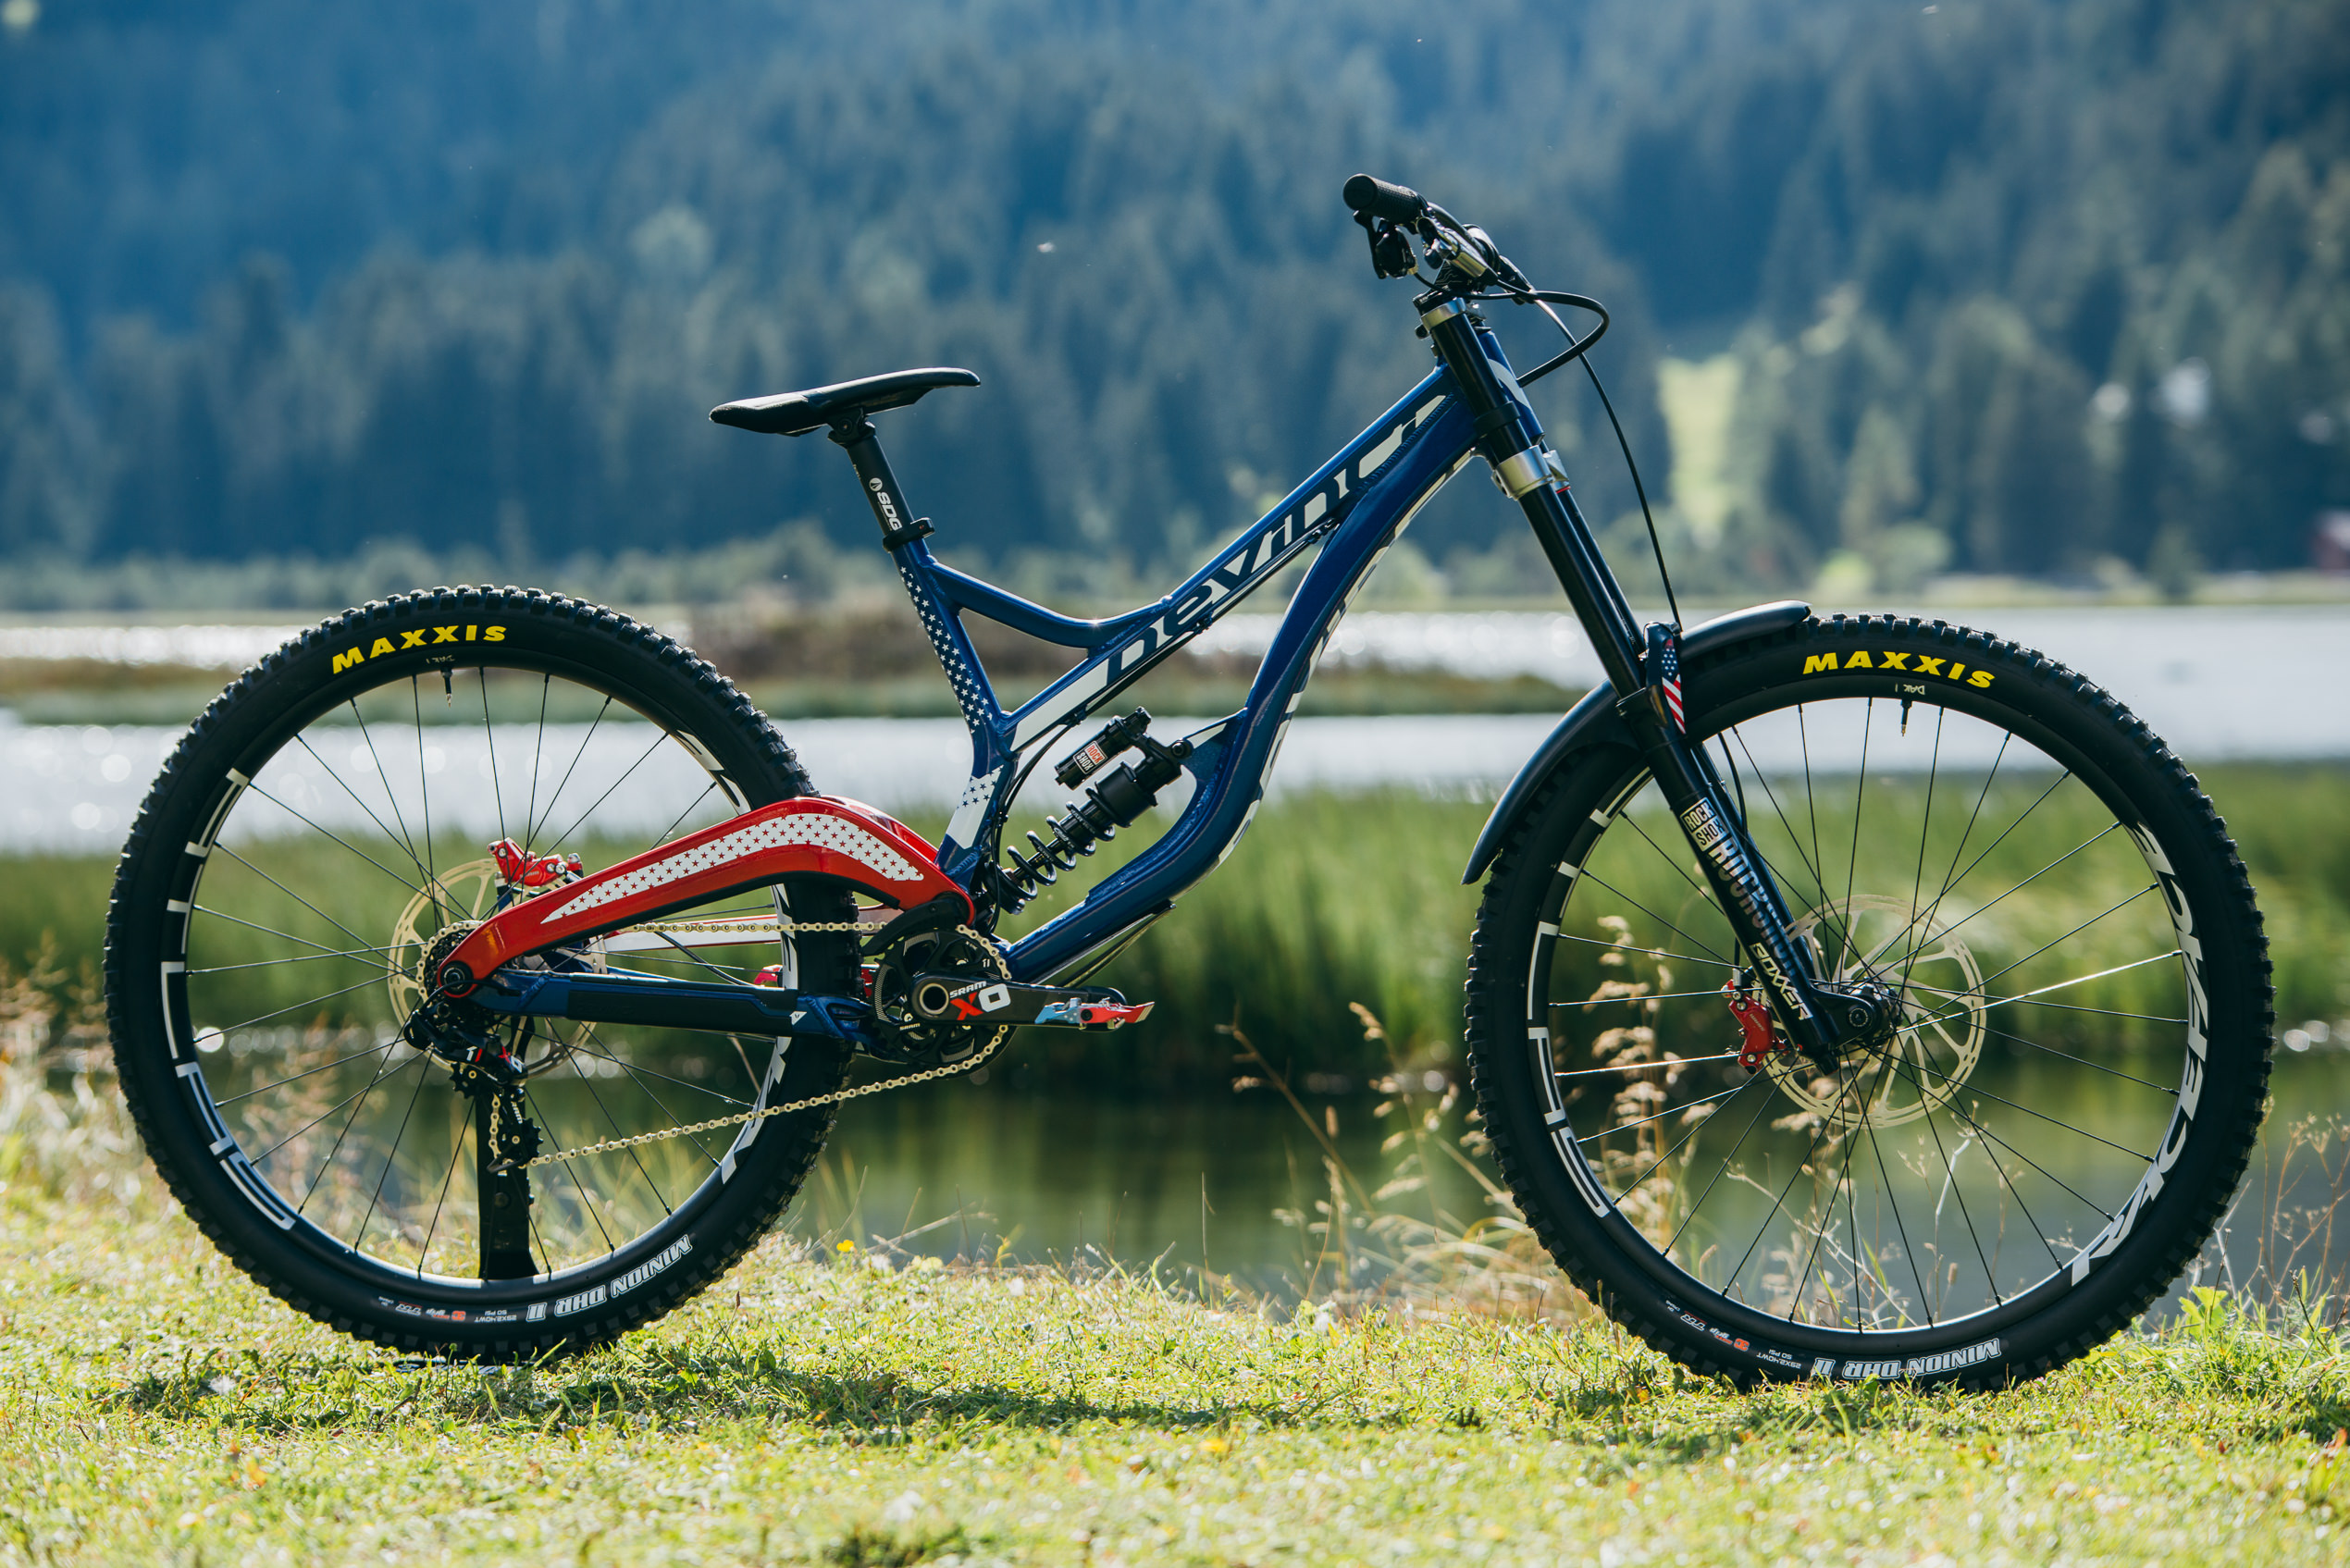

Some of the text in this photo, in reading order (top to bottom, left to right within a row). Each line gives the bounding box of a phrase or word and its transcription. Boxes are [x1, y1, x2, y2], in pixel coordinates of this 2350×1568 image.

[877, 491, 903, 531] SDG
[332, 624, 507, 674] MAXXIS
[1802, 650, 1996, 688] MAXXIS
[1076, 751, 1094, 772] SHOX
[1086, 745, 1104, 764] ROCK
[1683, 801, 1715, 831] ROCK
[1695, 817, 1728, 846] SHOX
[949, 981, 987, 999] SRAM
[1749, 942, 1814, 1021] BOXXER
[2071, 821, 2210, 1287] RACEFACE
[610, 1234, 693, 1298] MINION
[426, 1308, 446, 1316] grip
[554, 1285, 607, 1316] DHR
[451, 1310, 466, 1322] 3C
[1709, 1327, 1730, 1339] grip
[1733, 1338, 1750, 1352] 3C
[1756, 1352, 1802, 1369] 29X2.40WT
[1768, 1349, 1781, 1357] PSI
[1907, 1338, 2002, 1377] MINION
[1842, 1360, 1901, 1379] DHR
